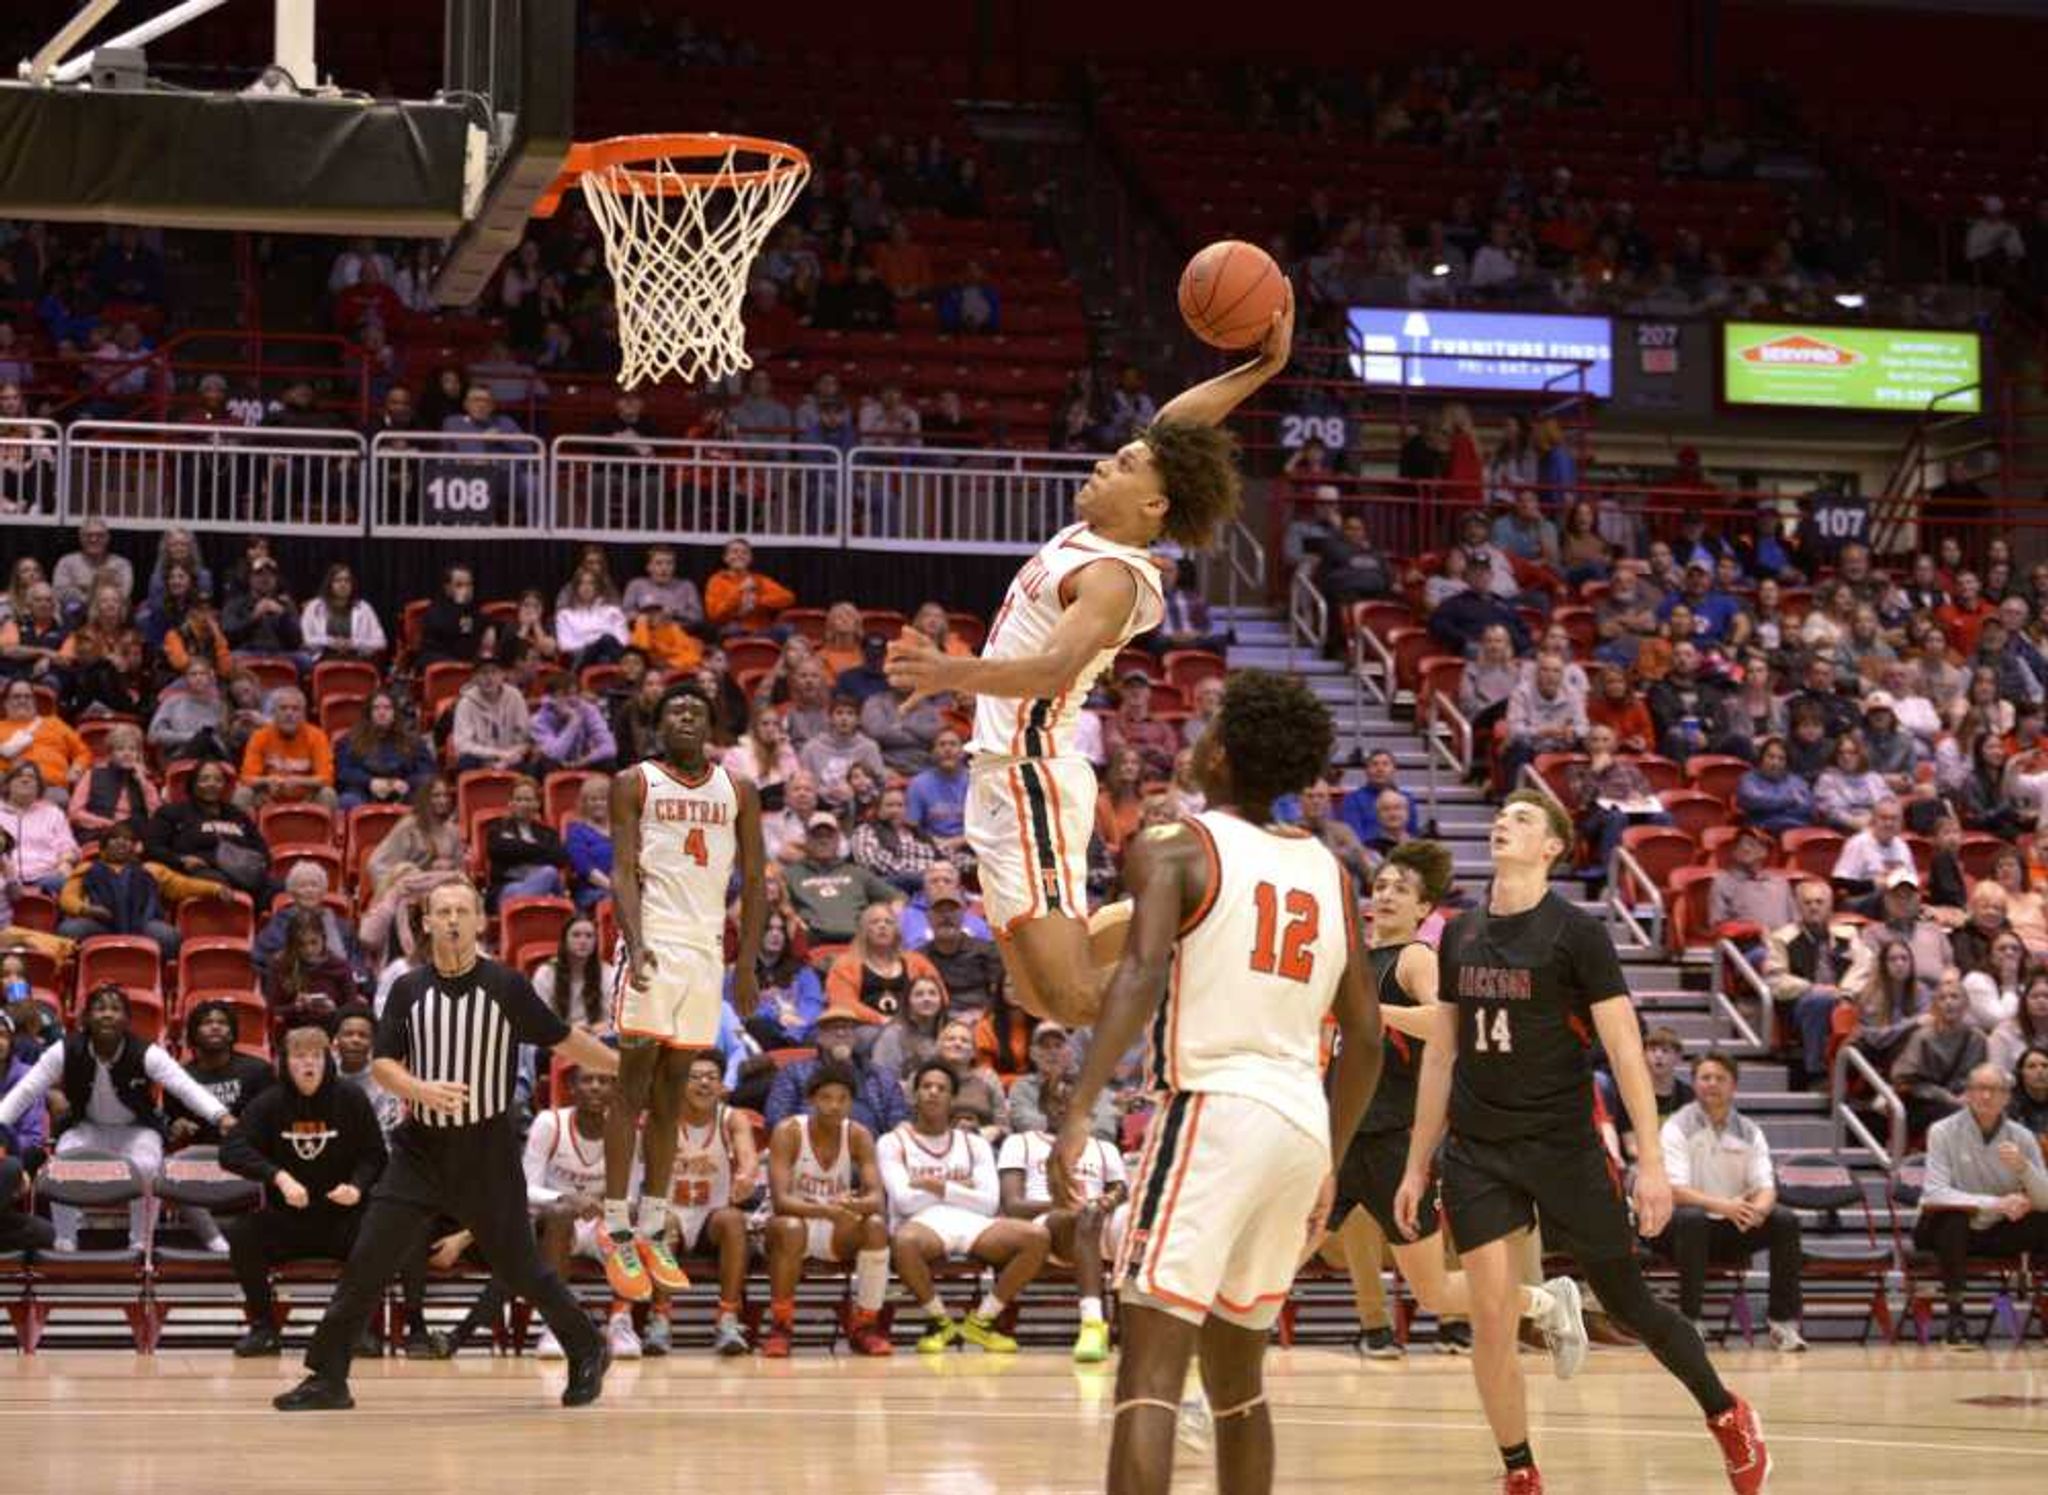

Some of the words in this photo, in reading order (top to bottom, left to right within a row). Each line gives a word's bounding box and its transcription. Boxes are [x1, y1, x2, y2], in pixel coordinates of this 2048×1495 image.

[1638, 324, 1678, 346] 207
[1282, 415, 1344, 448] 208
[427, 477, 490, 511] 108
[1814, 508, 1866, 537] 107
[655, 799, 727, 826] CENTRAL
[684, 828, 709, 867] 4
[1249, 880, 1319, 984] 12
[1474, 1007, 1512, 1053] 14
